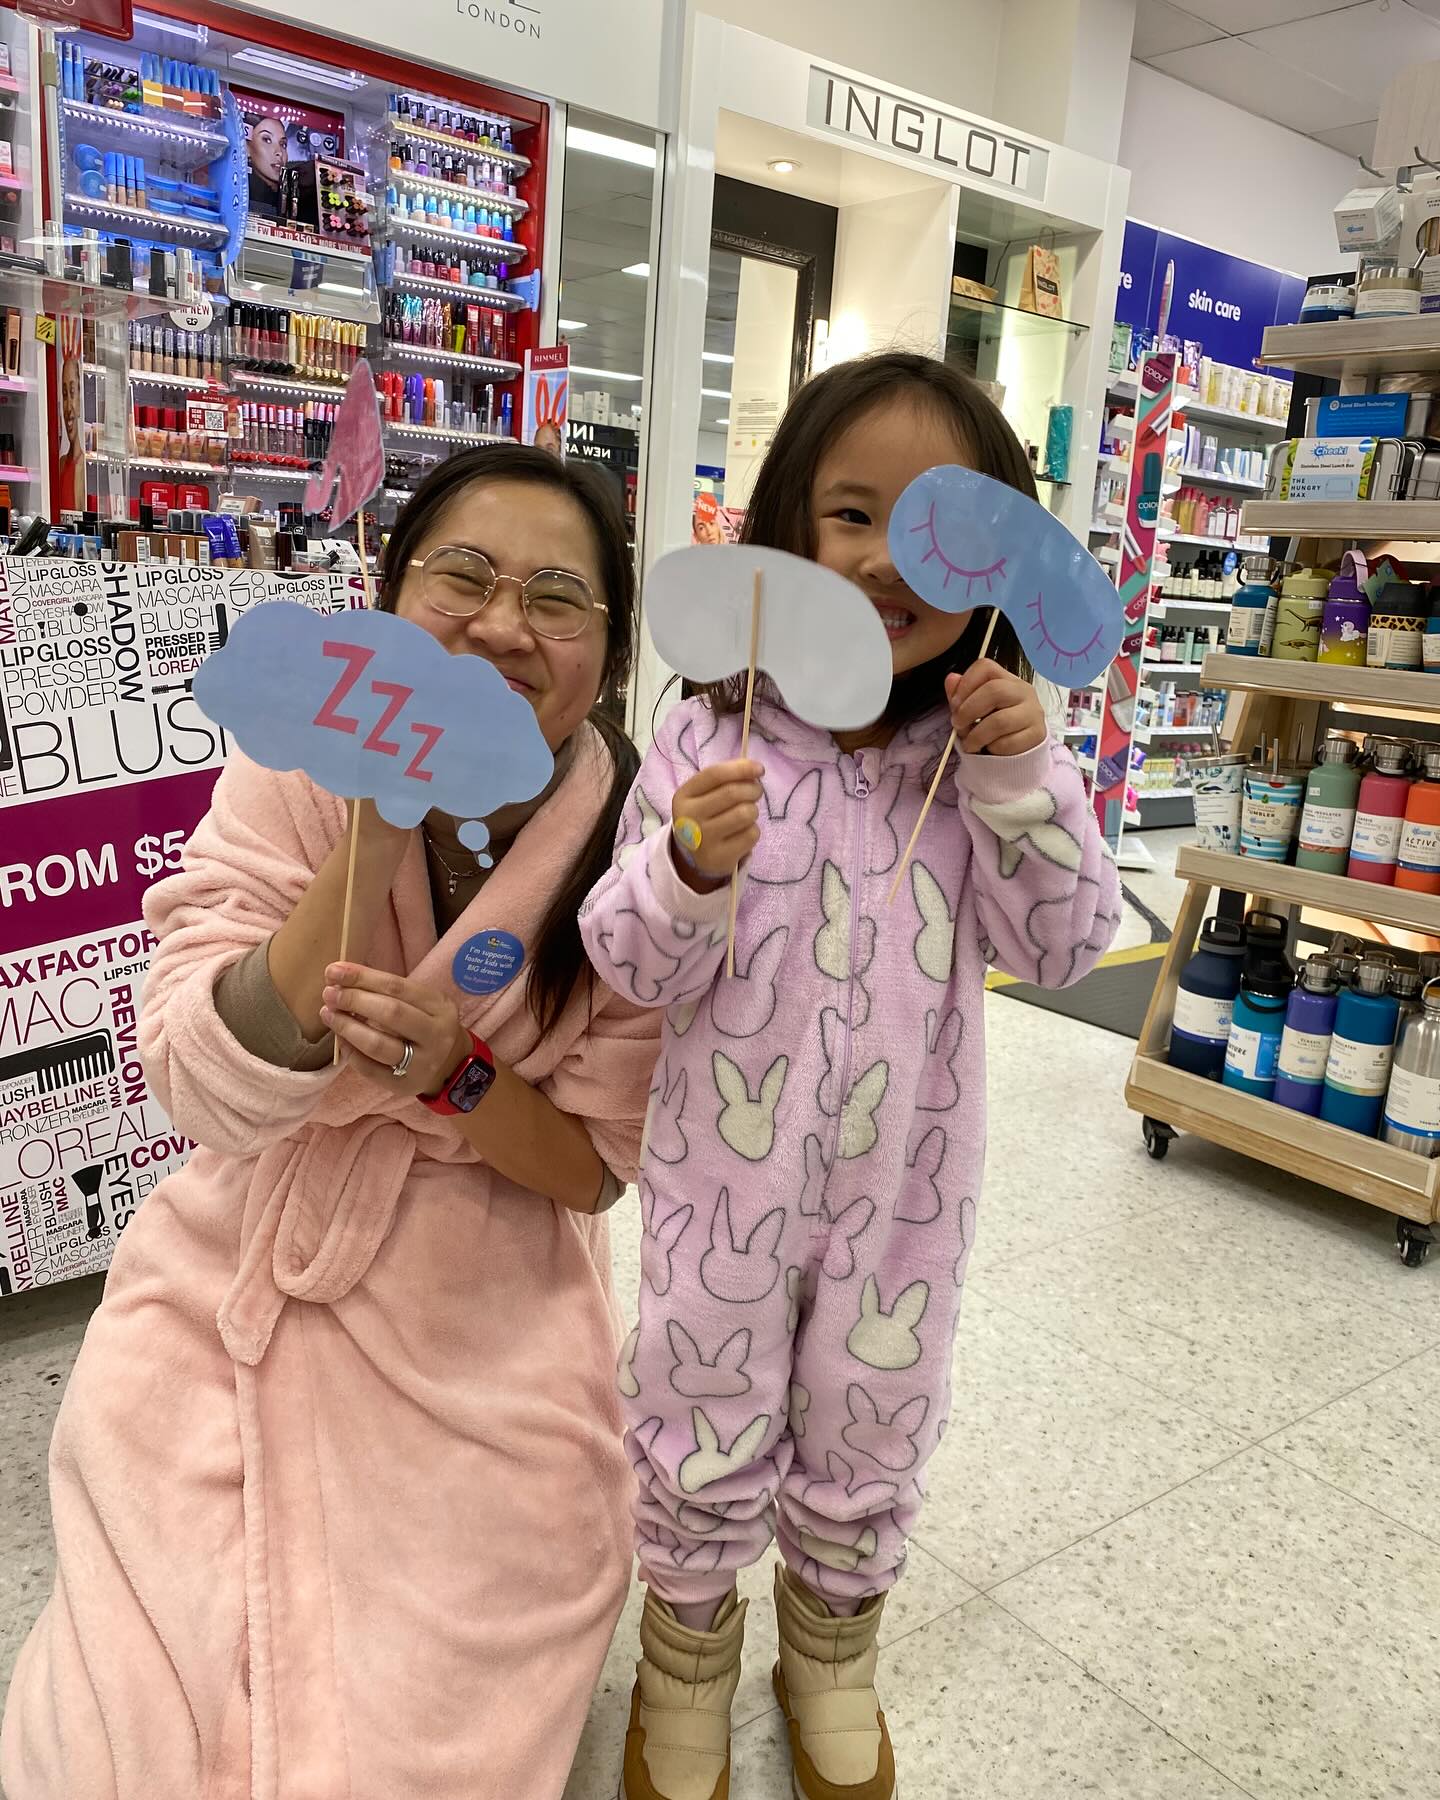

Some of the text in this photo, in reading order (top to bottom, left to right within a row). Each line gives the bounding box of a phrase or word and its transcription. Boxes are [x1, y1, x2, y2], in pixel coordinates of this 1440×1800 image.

[457, 0, 541, 39] LONDON
[824, 79, 1031, 186] INGLOT
[1188, 289, 1241, 321] skin care
[534, 352, 565, 363] RIMMEL
[6, 557, 36, 643] BRONZE
[30, 579, 102, 599] MASCARA
[137, 583, 226, 609] MASCARA
[32, 597, 72, 608] COVERGIRL
[48, 615, 108, 638] BLUSH
[101, 562, 145, 703] SHADOW
[140, 605, 214, 635] BLUSH
[145, 631, 206, 650] PRESSED
[147, 643, 207, 662] POWDER
[4, 657, 116, 693] PRESSED
[7, 681, 119, 719] POWDER
[1406, 838, 1438, 848] ACTIVE
[482, 949, 516, 963] supporting
[484, 958, 499, 968] kids
[466, 964, 504, 977] BIG dreams
[109, 984, 148, 1107] REVLON
[107, 1076, 122, 1109] MAC
[72, 1098, 107, 1114] MASCARA
[72, 1105, 109, 1122] EYELINER
[27, 1184, 41, 1225] EYELINER
[38, 1180, 57, 1229] BLUSH
[53, 1176, 69, 1212] MAC
[20, 1188, 33, 1227] MASCARA
[46, 1219, 84, 1236] MASCARA
[47, 1224, 85, 1245] EYELINER
[50, 1237, 116, 1269] MASCARA
[52, 1260, 89, 1277] COVERGIRL
